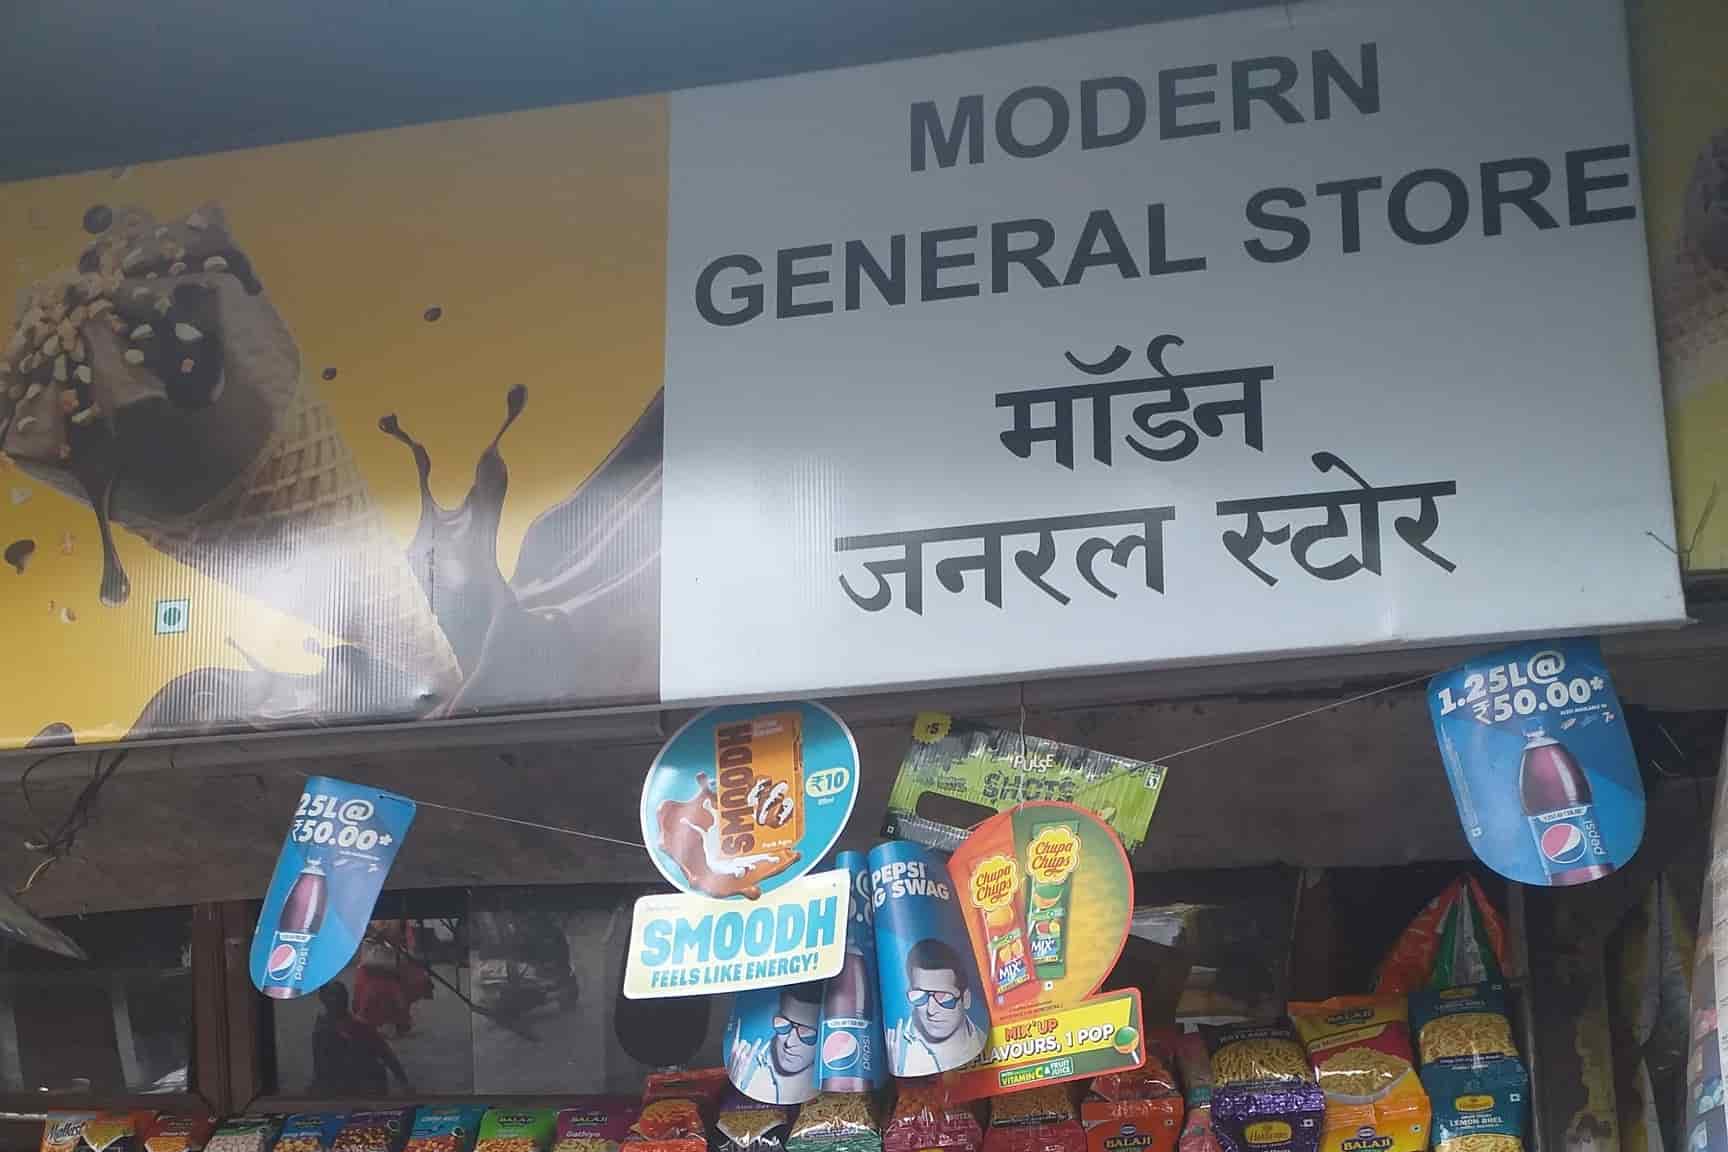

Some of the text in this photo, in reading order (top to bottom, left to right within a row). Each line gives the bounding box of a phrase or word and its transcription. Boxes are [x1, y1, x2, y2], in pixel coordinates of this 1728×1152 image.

[908, 42, 1382, 172] MODERN
[693, 143, 1637, 327] GENERAL STORE
[995, 333, 1274, 470] मॉर्डन
[835, 451, 1457, 615] जनरल स्टोर
[1437, 650, 1566, 716] 1.25L@
[716, 722, 755, 855] SMOODH
[809, 770, 844, 793] ₹10
[1035, 839, 1074, 857] Chupa
[872, 860, 928, 891] PEPSI
[975, 864, 1012, 887] Chupa
[1032, 853, 1071, 876] Chups
[890, 879, 950, 900] SWAG
[976, 879, 1013, 904] Chups
[640, 895, 838, 967] SMOODH
[651, 952, 820, 988] FEELS LIKE ENERGY!
[1065, 1031, 1074, 1048] 1
[1077, 1023, 1115, 1045] POP
[1105, 1136, 1152, 1149] BALAJI
[1342, 1137, 1392, 1151] BALAJI
